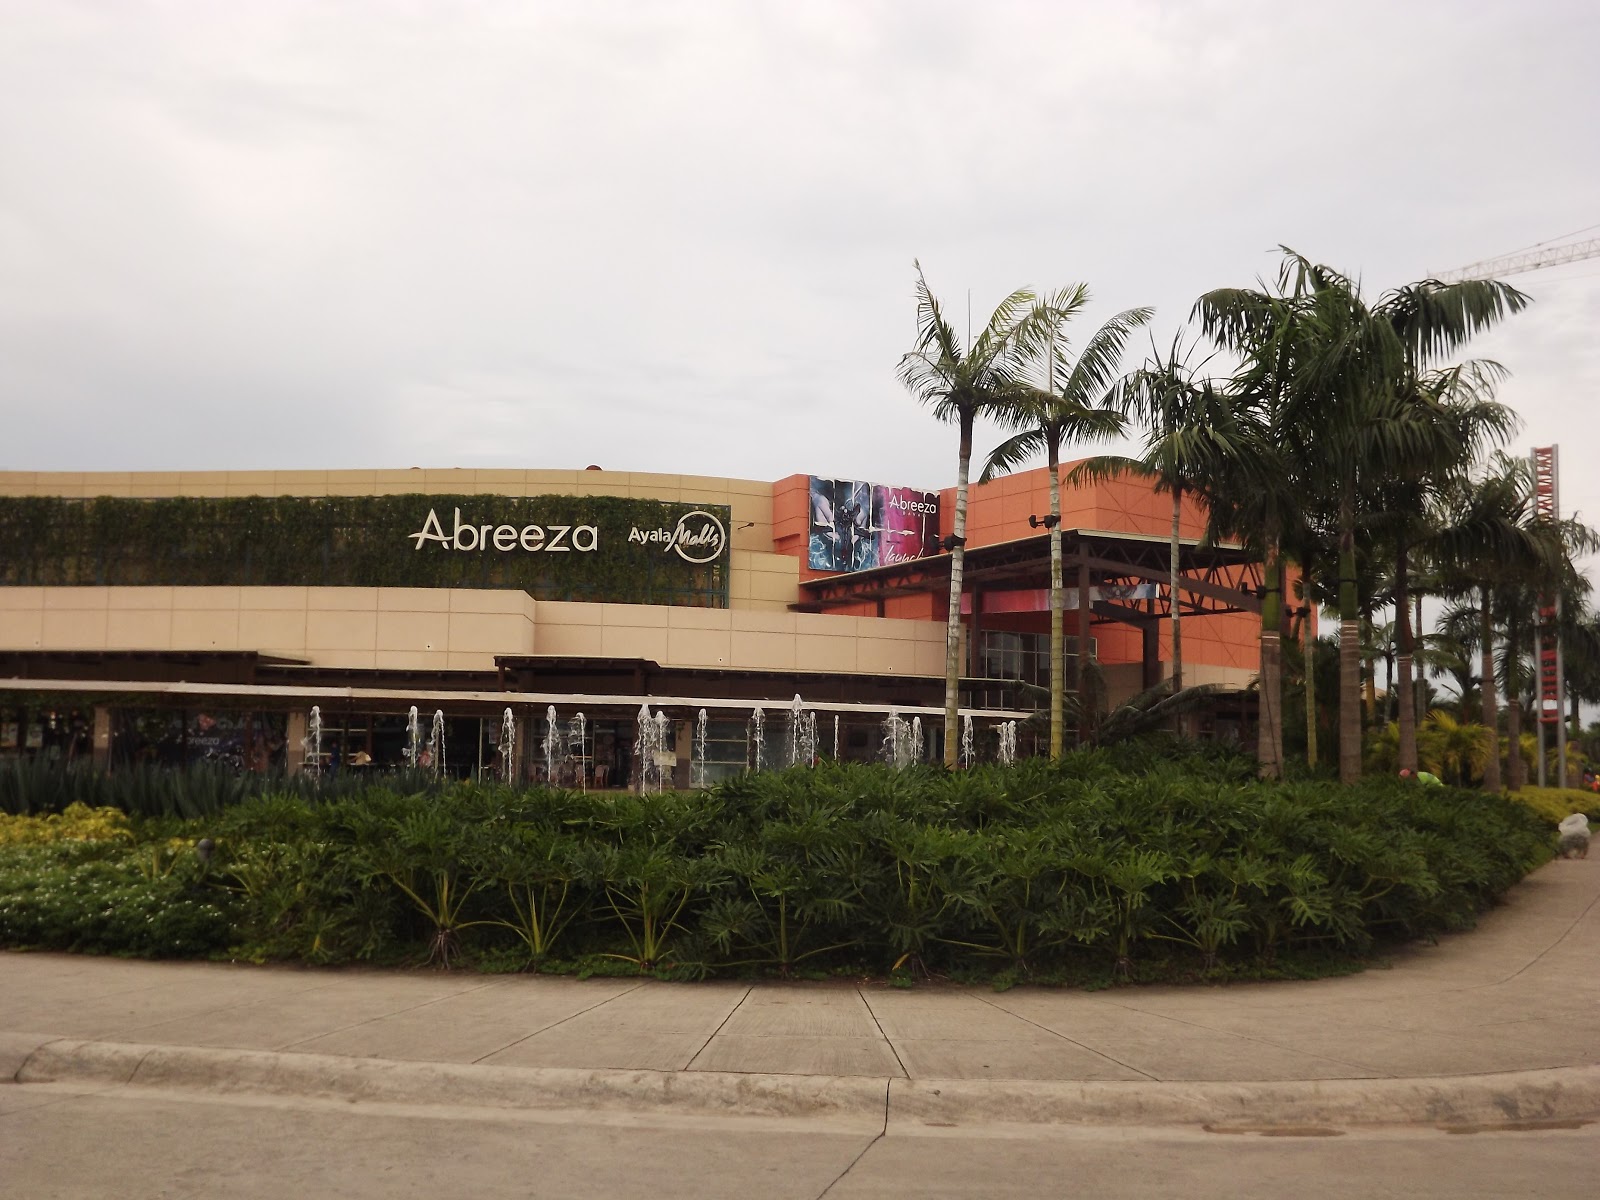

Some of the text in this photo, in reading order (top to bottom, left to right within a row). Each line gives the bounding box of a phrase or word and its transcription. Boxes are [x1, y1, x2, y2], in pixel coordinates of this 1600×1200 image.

[889, 494, 936, 514] Abreeza
[409, 508, 598, 552] Abreeza
[628, 523, 719, 553] Ayala Malls
